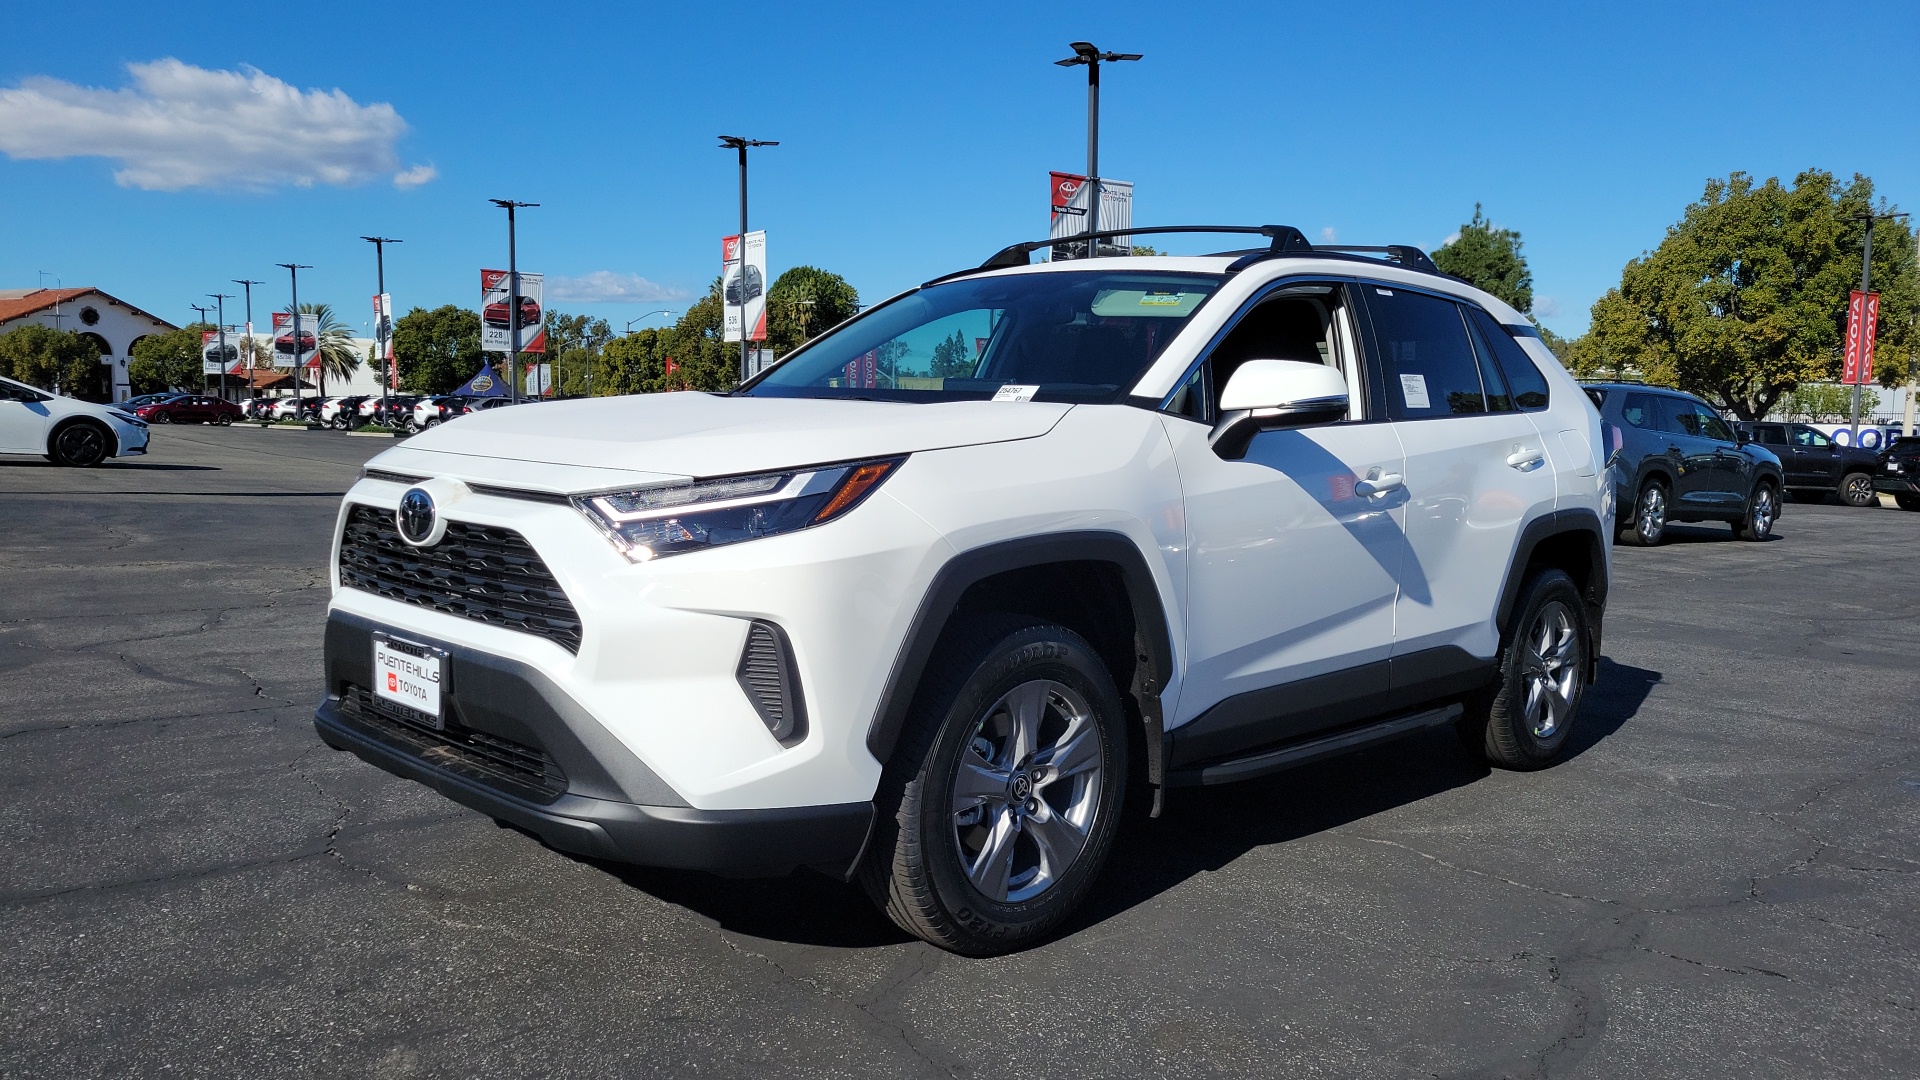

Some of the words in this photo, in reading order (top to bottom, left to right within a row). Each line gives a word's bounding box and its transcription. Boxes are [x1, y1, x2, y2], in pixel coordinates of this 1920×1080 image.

[489, 331, 503, 339] 228
[1846, 297, 1860, 379] TOYOTA
[1862, 298, 1875, 377] TOYOTA
[388, 639, 423, 656] TOYOTA
[377, 651, 412, 674] PUENTE
[412, 664, 440, 684] HILLS
[398, 678, 427, 702] TOYOTA
